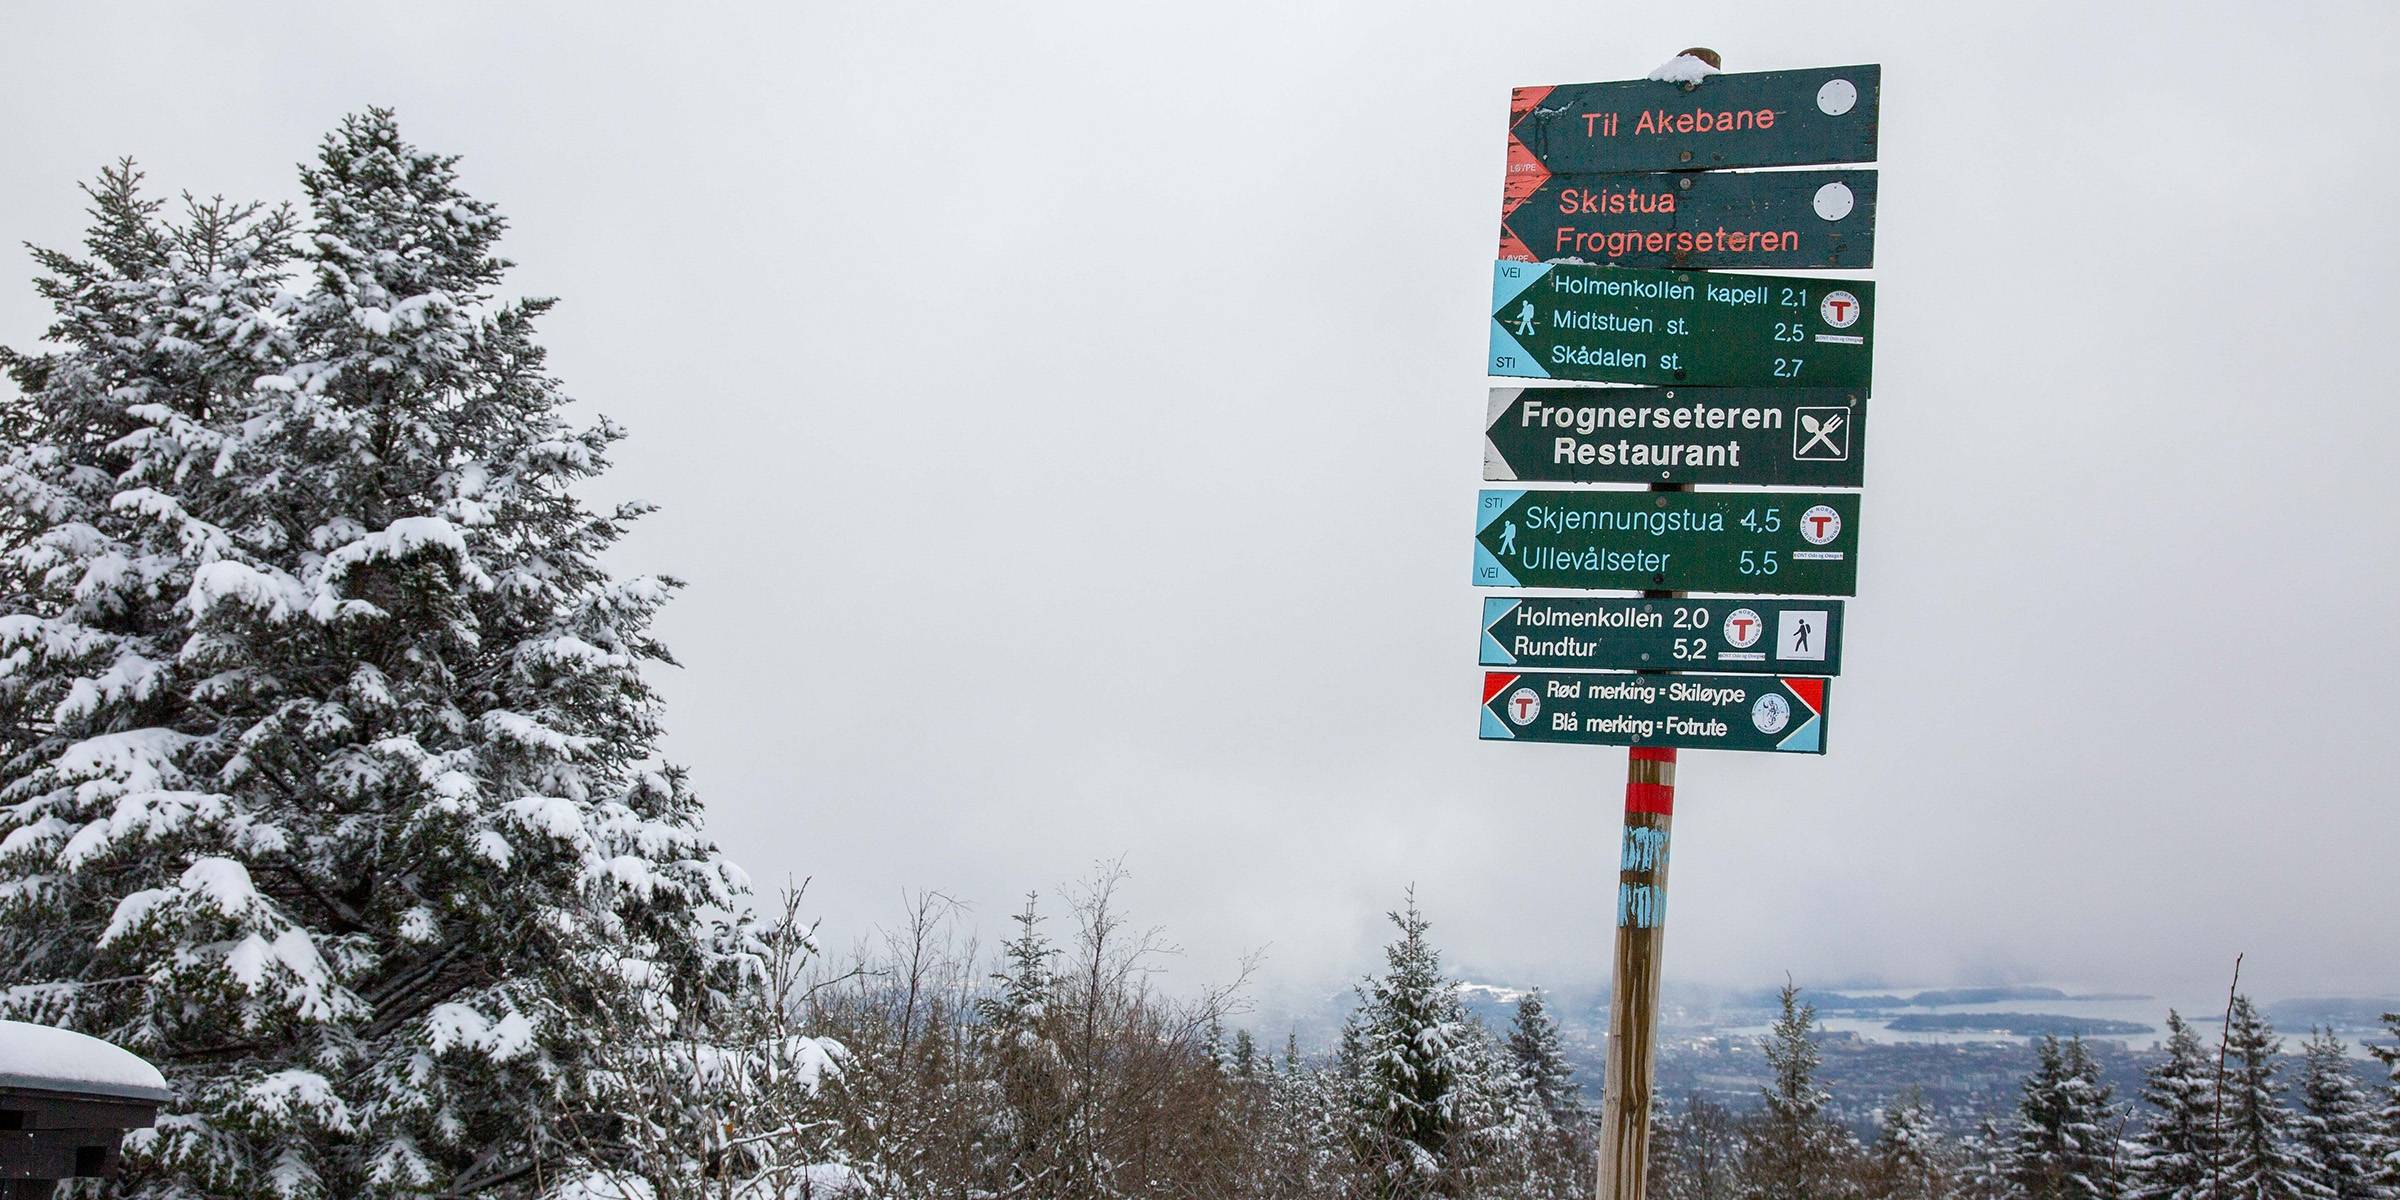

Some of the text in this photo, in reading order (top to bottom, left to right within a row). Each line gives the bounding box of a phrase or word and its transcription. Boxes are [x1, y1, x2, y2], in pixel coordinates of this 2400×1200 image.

[1582, 108, 1775, 138] Til Akebane
[1559, 188, 1675, 214] Skistua
[1556, 226, 1799, 257] Frognerseteren
[1501, 266, 1521, 279] VEI
[1555, 275, 1807, 308] Holmenkollen kapell 2,1
[1553, 310, 1653, 334] Midtstuen
[1666, 317, 1689, 336] st.
[1774, 322, 1805, 343] 2,5
[1495, 356, 1516, 369] STI
[1551, 344, 1804, 378] Skådalen st. 2,7
[1521, 400, 1782, 435] Frognerseteren
[1553, 437, 1740, 467] Restaurant
[1484, 497, 1504, 509] STI
[1525, 505, 1781, 537] Skjennungstua 4,5
[1480, 567, 1499, 579] VEI
[1522, 546, 1778, 576] Ullevålseter 5,5
[1516, 606, 1710, 631] Holmenkollen 2,0
[1514, 635, 1708, 662] Rundtur 5,2
[1546, 680, 1581, 699] Rød
[1588, 681, 1656, 705] merking
[1668, 682, 1746, 706] Skiløype
[1551, 711, 1578, 732] Blå
[1586, 715, 1654, 738] merking
[1665, 716, 1728, 737] Fotrute
